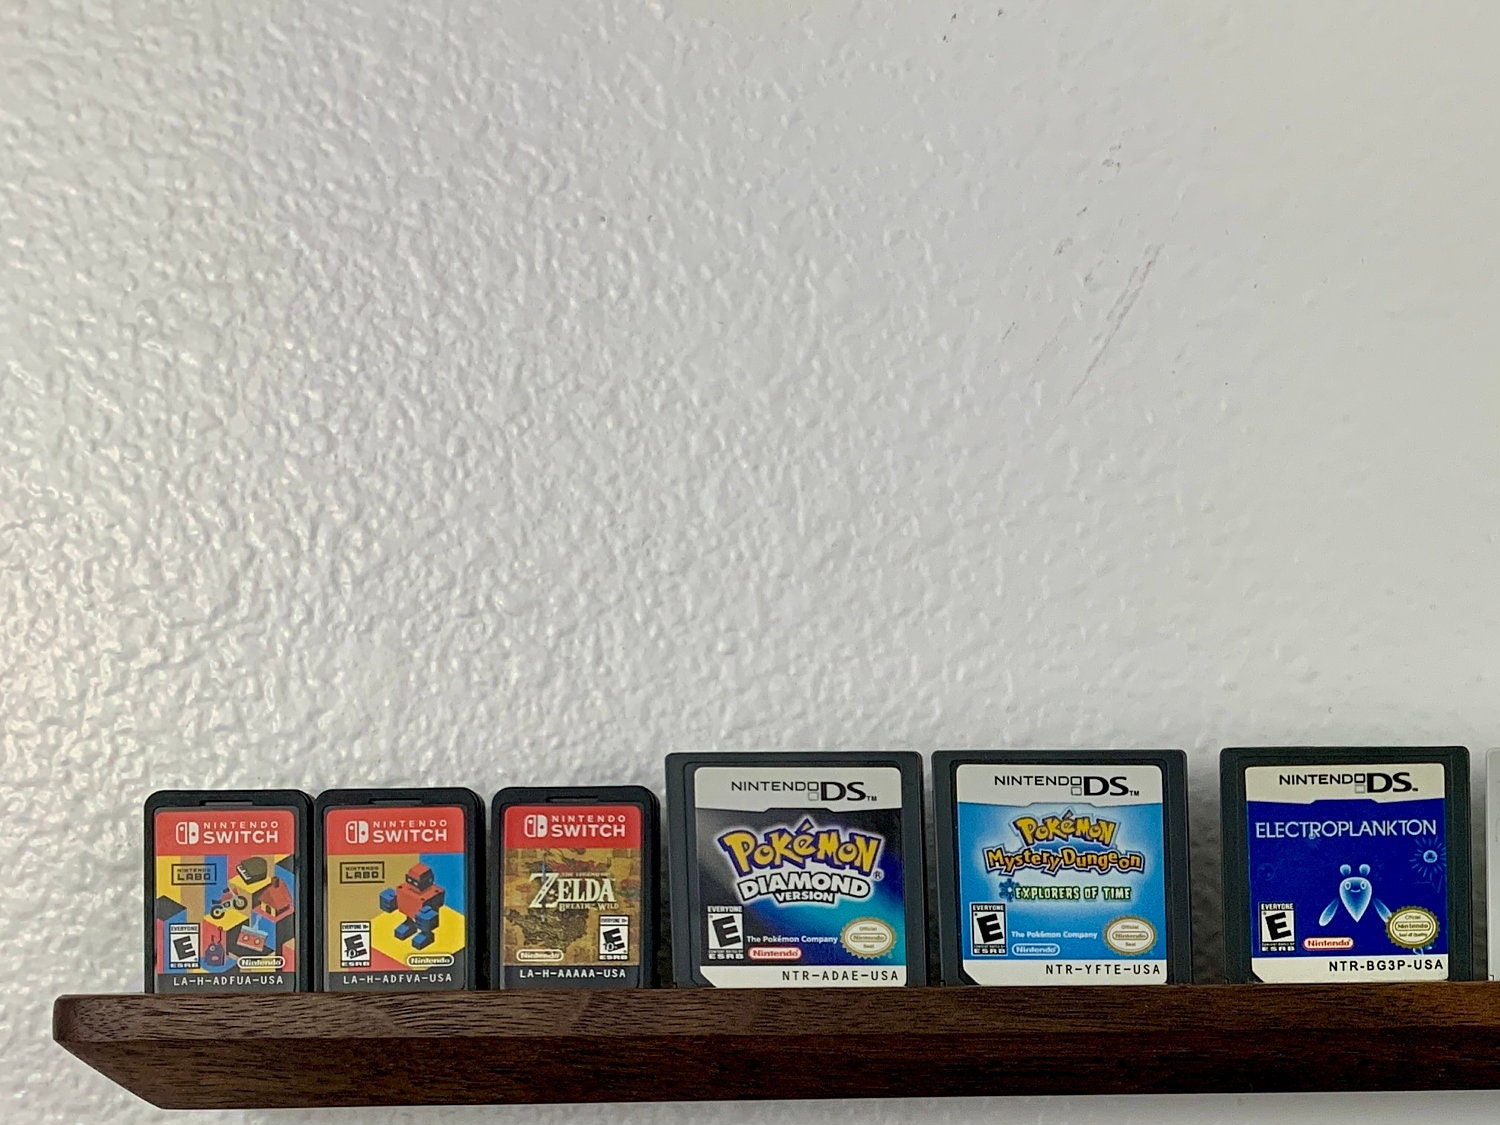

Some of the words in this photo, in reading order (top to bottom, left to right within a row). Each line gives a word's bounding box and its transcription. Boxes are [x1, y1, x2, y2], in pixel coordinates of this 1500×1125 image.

[994, 776, 1082, 786] NINTENDO
[1279, 774, 1366, 785] NINTENDO
[731, 782, 819, 791] NINTENDO
[203, 821, 279, 829] NINTENDO
[373, 820, 447, 828] NINTENDO
[1255, 820, 1436, 838] ELECTROPLANKTON
[551, 824, 626, 837] SWITCH
[203, 831, 279, 844] SWITCH
[373, 829, 447, 843] SWITCH
[1060, 848, 1145, 873] Dungeon
[177, 873, 211, 881] LABO
[528, 873, 617, 908] ZELDA
[738, 872, 871, 902] DIAMOND
[776, 892, 835, 904] VERSION
[1015, 887, 1079, 900] EXPLORERS
[1083, 887, 1098, 900] OF
[1102, 887, 1131, 900] TIME
[763, 935, 799, 943] Pokémon
[801, 936, 838, 945] Company
[1063, 931, 1097, 941] Company
[753, 949, 799, 957] Nintendo
[1046, 965, 1160, 975] NTR-YFTE-USA
[1329, 961, 1443, 971] NTR-BG3P-USA
[343, 973, 452, 984] LA-H-ADFVA-USA
[520, 969, 626, 978] LA-H-AAAAA-USA
[782, 971, 898, 981] NTR-ADAE-USA
[174, 975, 283, 986] LA-H-ADFUA-USA
